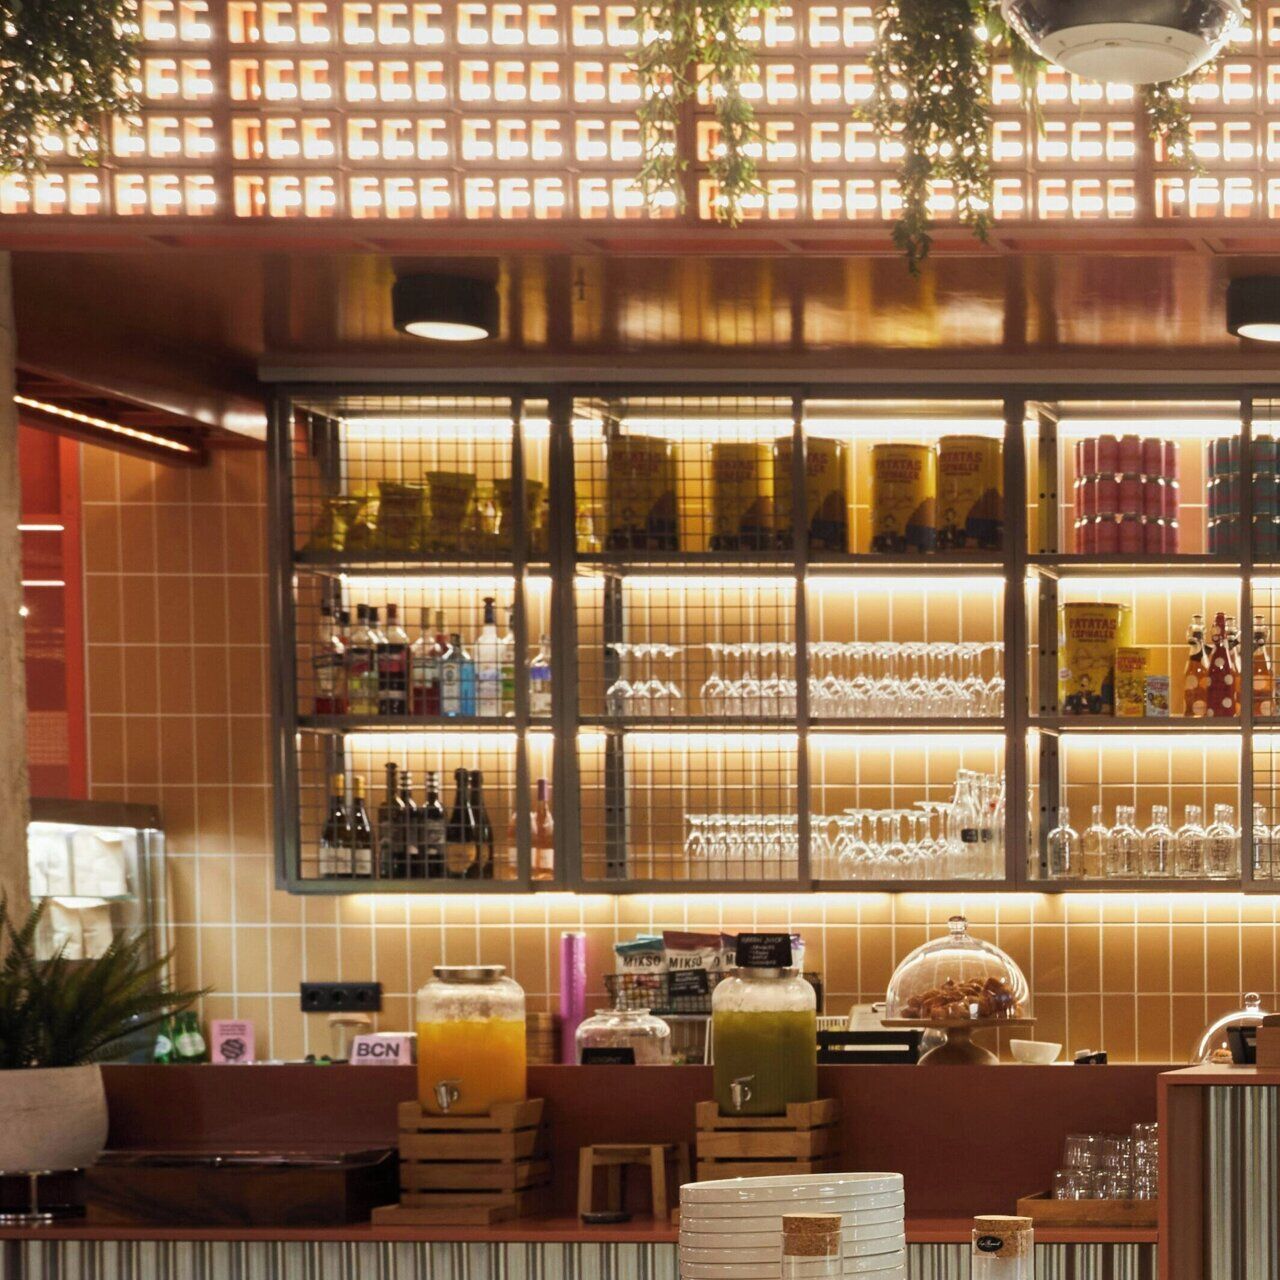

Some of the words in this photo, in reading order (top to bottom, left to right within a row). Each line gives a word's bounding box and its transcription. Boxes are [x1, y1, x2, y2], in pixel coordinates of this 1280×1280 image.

[1069, 618, 1117, 630] PATATAS
[623, 955, 662, 967] MIKSO
[669, 956, 703, 969] MIKSO
[356, 1042, 400, 1057] BCN
